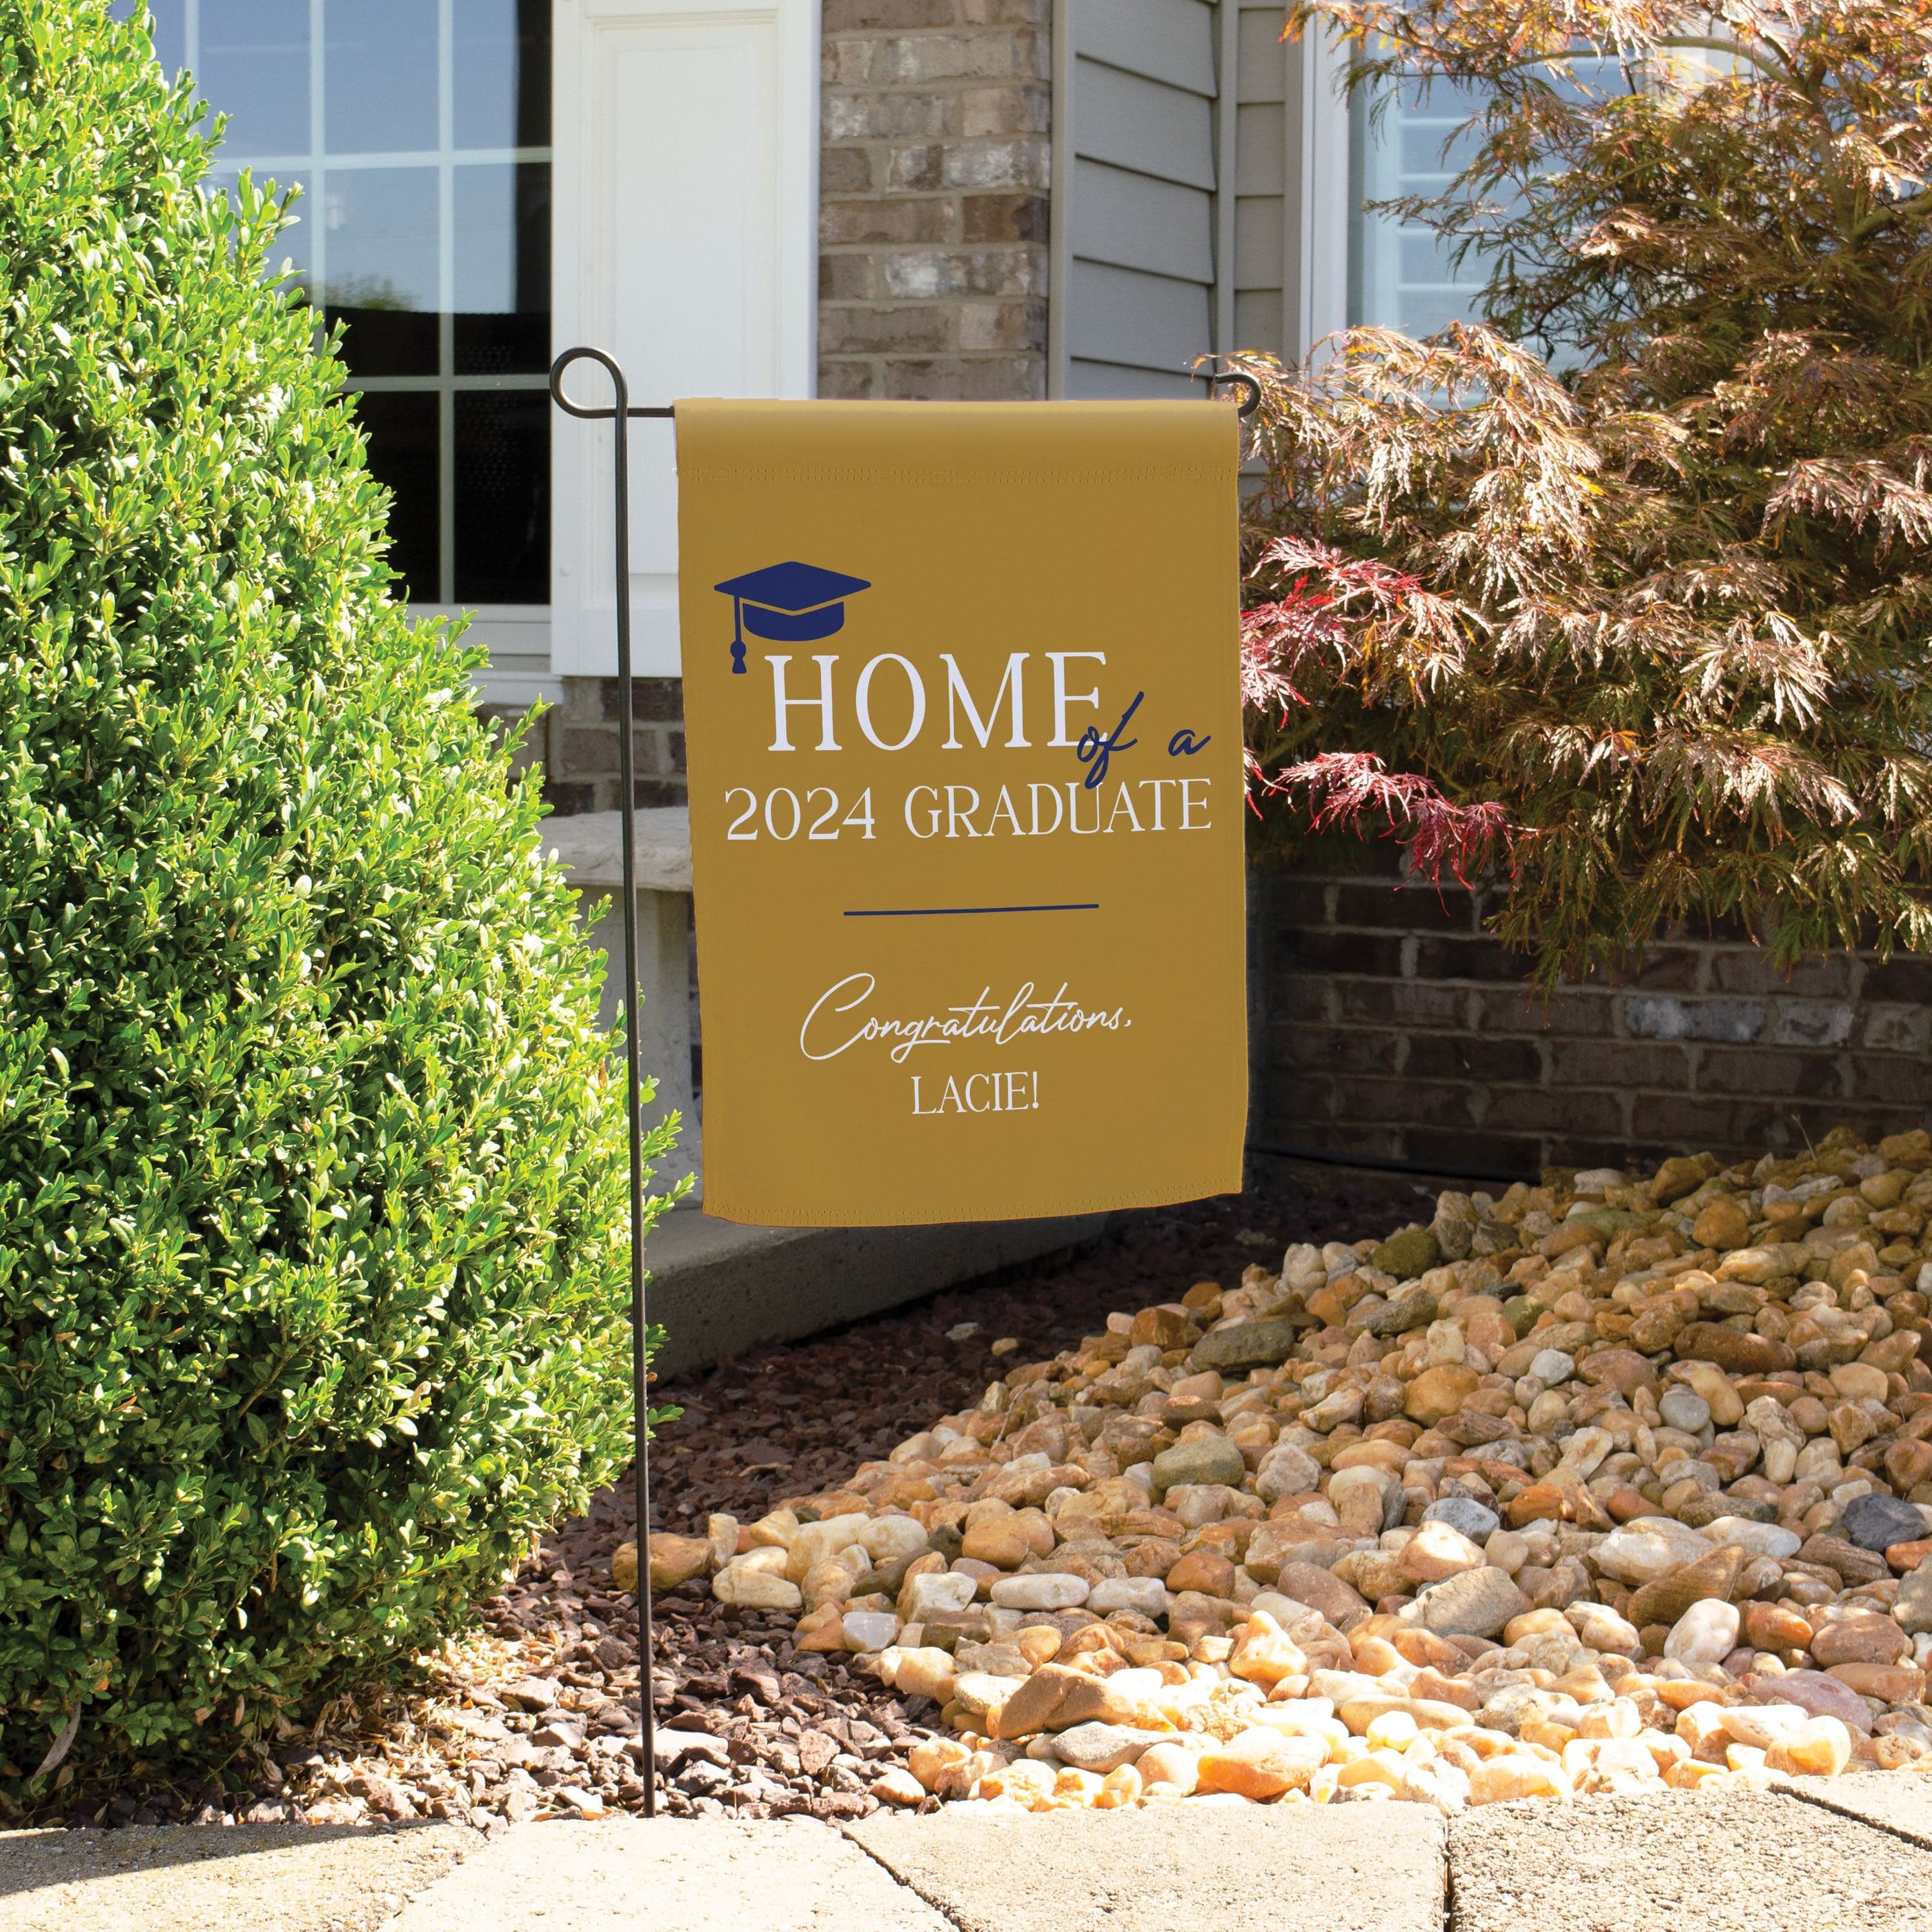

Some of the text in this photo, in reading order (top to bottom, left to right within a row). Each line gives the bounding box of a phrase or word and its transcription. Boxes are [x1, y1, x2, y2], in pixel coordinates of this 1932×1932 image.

[764, 651, 1211, 789] HOME of a
[725, 778, 1212, 840] 2024 GRADUATE
[800, 972, 1132, 1063] Congratulations,
[911, 1071, 1039, 1114] LACIE!
